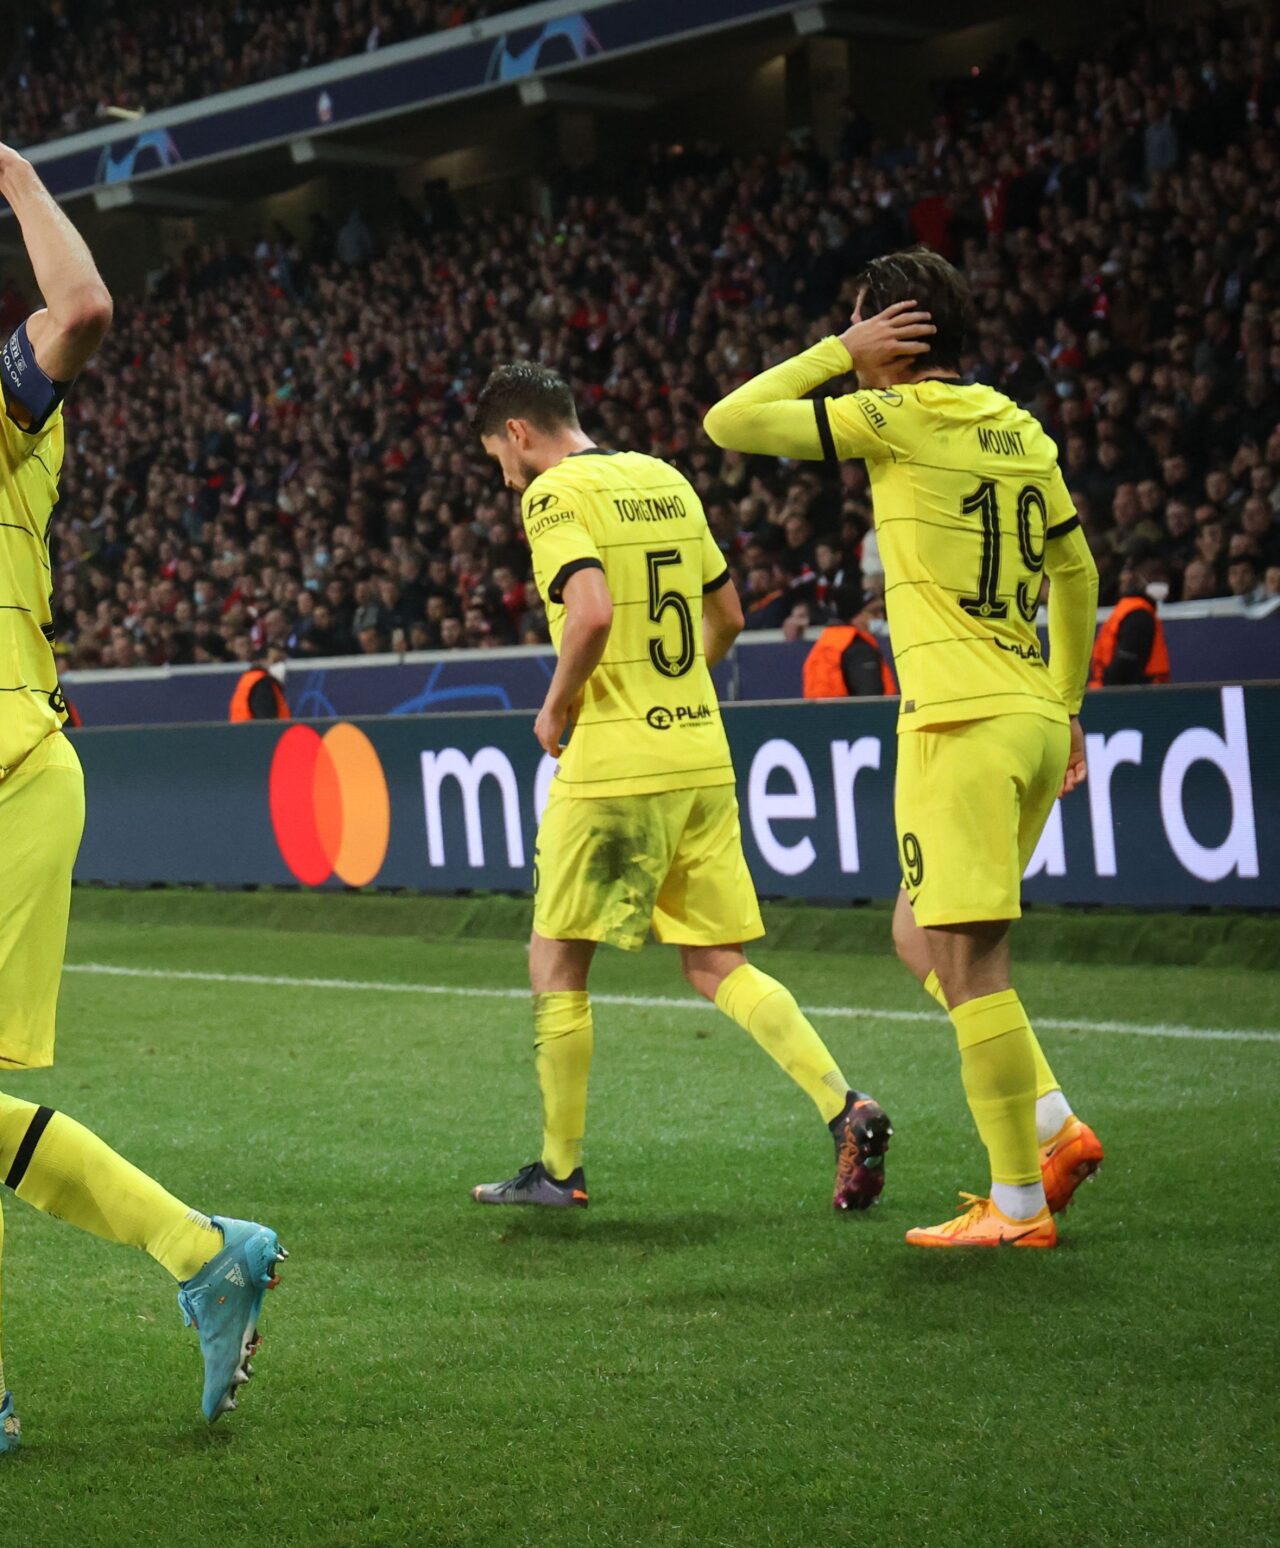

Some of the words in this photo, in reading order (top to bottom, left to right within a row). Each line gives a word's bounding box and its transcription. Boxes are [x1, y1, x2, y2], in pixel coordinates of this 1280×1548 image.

[977, 427, 1027, 456] MOUNT
[613, 495, 687, 523] JORGINHO
[959, 481, 1048, 623] 19
[645, 549, 695, 678] 5
[676, 704, 711, 720] PLAN
